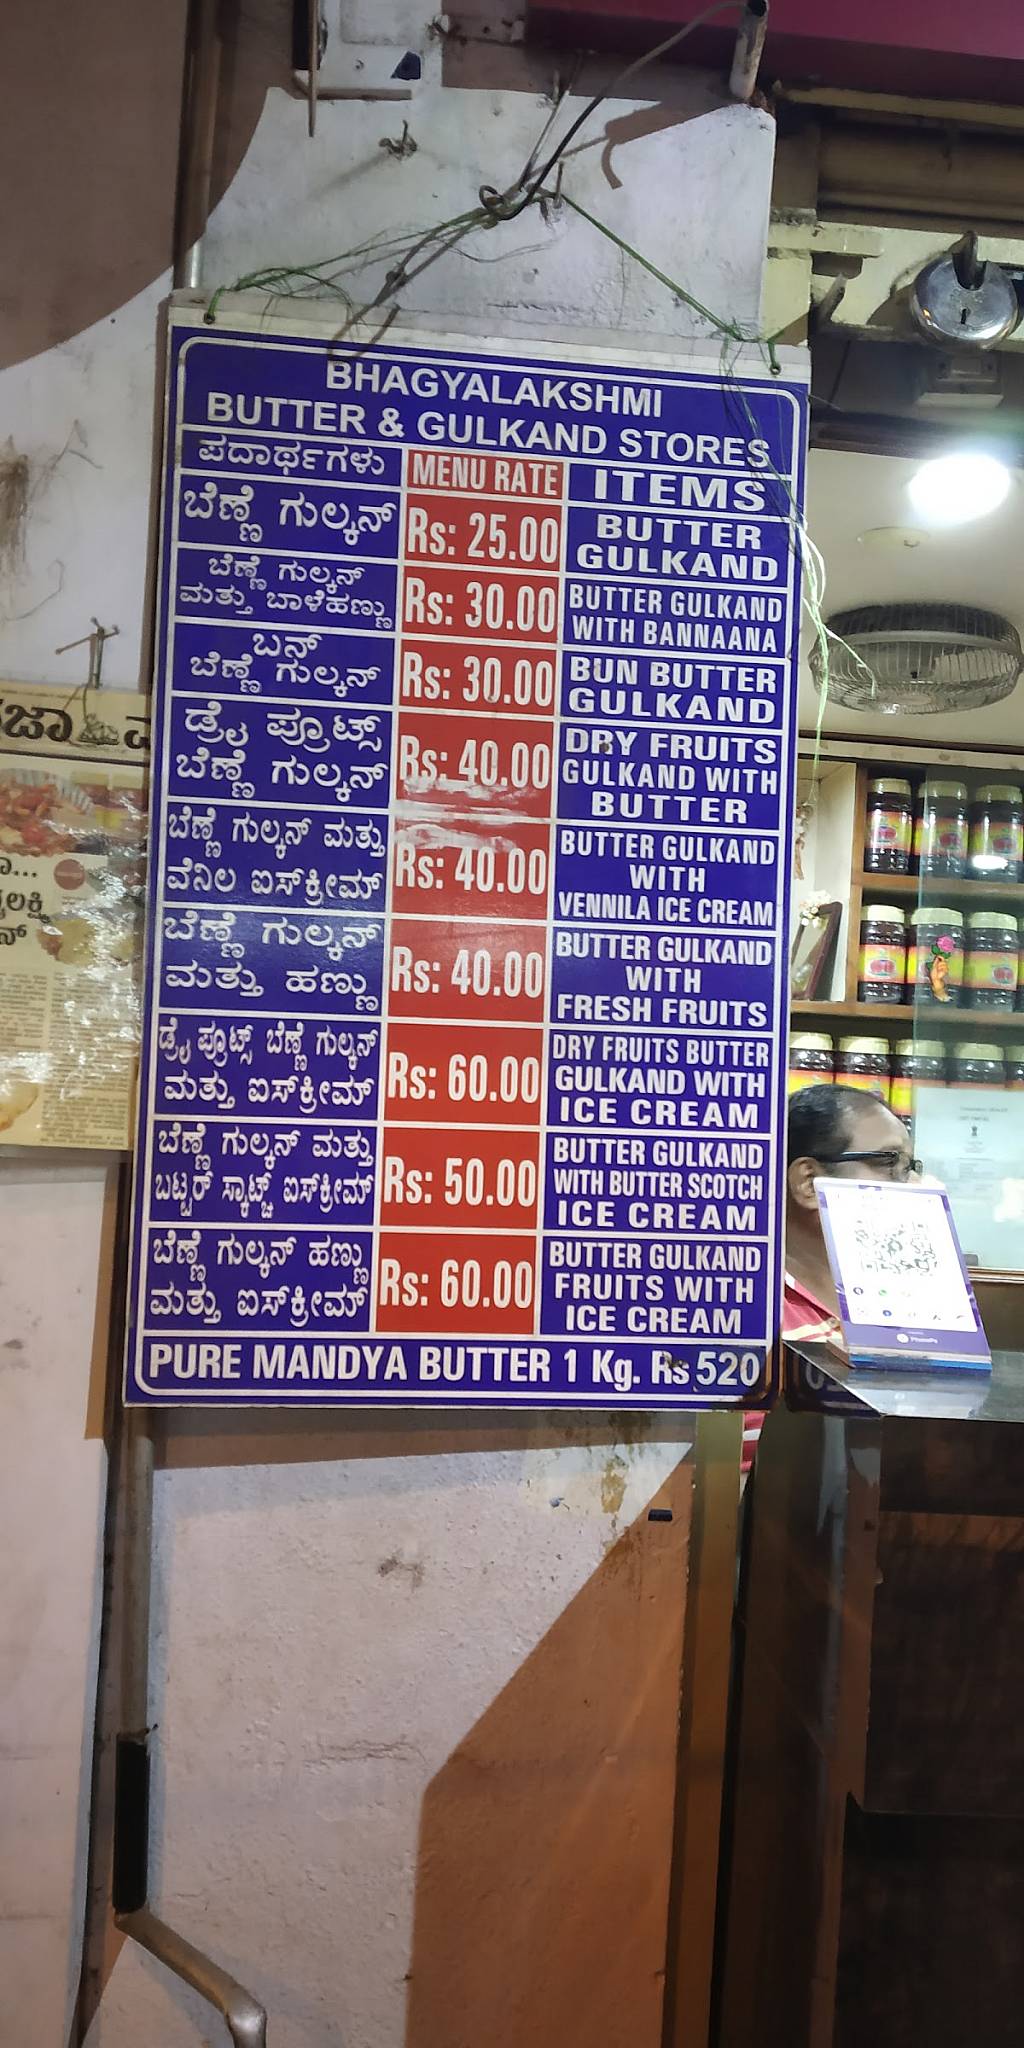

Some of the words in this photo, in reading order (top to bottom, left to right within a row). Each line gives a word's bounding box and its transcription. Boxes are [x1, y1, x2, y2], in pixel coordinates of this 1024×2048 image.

[327, 362, 661, 417] BHAGYALAKSHMI
[208, 392, 365, 434] BUTTER
[378, 408, 404, 437] &
[418, 412, 606, 453] GULKAND
[619, 429, 772, 467] STORES
[200, 435, 384, 475] ಪದಾರ್ಥಗಳು
[413, 453, 486, 489] MENU
[495, 461, 558, 495] RATE
[595, 469, 765, 511] ITEMS
[184, 482, 262, 542] ಬೆಣ್ಣೆ
[280, 492, 396, 545] ಗುಲ್ಕನ್
[597, 514, 761, 549] BUTTER
[408, 507, 455, 555] Rs:
[468, 513, 558, 563] 25.00
[209, 554, 266, 590] ಬೆಣ್ಣೆ
[279, 561, 364, 594] ಗುಲ್ಕನ್
[577, 544, 777, 581] GULKAND
[181, 583, 253, 614] ಮತ್ತು
[267, 590, 392, 628] ಬಾಳೆಹಣ್ಣು
[405, 577, 453, 625] Rs:
[465, 582, 555, 632] 30.00
[570, 584, 662, 614] BUTTER
[671, 591, 782, 622] GULKAND
[253, 634, 322, 658] ಬನ್
[573, 615, 634, 643] WITH
[644, 620, 776, 652] BANNAANA
[191, 652, 260, 693] ಬೆಣ್ಣೆ
[277, 659, 380, 697] ಗುಲ್ಕನ್
[403, 652, 450, 699] Rs:
[463, 656, 552, 706] 30.00
[571, 656, 637, 684] BUN
[650, 662, 776, 693] BUTTER
[185, 701, 248, 746] ಡ್ರೈ
[569, 688, 774, 723] GULKAND
[400, 735, 447, 782] Rs:
[458, 739, 551, 790] 40.00
[566, 728, 637, 755] DRY
[650, 733, 776, 764] FRUITS
[177, 747, 255, 798] ಬೆಣ್ಣೆ
[272, 755, 388, 802] ಗುಲ್ಕನ್
[563, 759, 695, 790] GULKAND
[706, 767, 777, 794] WITH
[592, 791, 746, 823] BUTTER
[169, 806, 221, 857] ಬೆಣ್ಣೆ
[233, 813, 311, 859] ಗುಲ್ಕನ್
[324, 818, 385, 857] ಮತ್ತು
[561, 830, 654, 859] BUTTER
[663, 836, 774, 864] GULKAND
[168, 858, 236, 892] ವೆನಿಲ
[395, 840, 444, 889] Rs:
[455, 849, 546, 894] 40.00
[630, 865, 705, 892] WITH
[559, 892, 650, 920] VENNILA
[658, 897, 691, 922] ICE
[698, 899, 773, 926] CREAM
[164, 912, 245, 958] ಬೆಣ್ಣೆ
[262, 917, 381, 961] ಗುಲ್ಕನ್
[556, 932, 650, 960] BUTTER
[658, 937, 772, 965] GULKAND
[166, 960, 263, 996] ಮತ್ತು
[286, 965, 378, 1011] ಹಣ್ಣು
[392, 946, 441, 993] Rs:
[450, 949, 543, 996] 40.00
[626, 966, 701, 993] WITH
[558, 994, 651, 1022] FRESH
[663, 999, 766, 1027] FRUITS
[159, 1017, 190, 1064] ಡ್ರೈ
[267, 1021, 307, 1071] ಬೆಣ್ಣೆ
[316, 1025, 378, 1070] ಗುಲ್ಕನ್
[553, 1034, 595, 1060] DRY
[603, 1036, 678, 1063] FRUITS
[687, 1040, 768, 1066] BUTTER
[165, 1070, 235, 1108] ಮತ್ತು
[388, 1052, 436, 1099] Rs:
[448, 1054, 539, 1103] 60.00
[556, 1065, 685, 1094] GULKAND
[694, 1071, 765, 1097] WITH
[561, 1097, 617, 1123] ICE
[631, 1099, 757, 1128] CREAM
[159, 1122, 210, 1170] ಬೆಣ್ಣೆ
[222, 1127, 300, 1170] ಗುಲ್ಕನ್
[313, 1129, 373, 1166] ಮತ್ತು
[554, 1137, 645, 1165] BUTTER
[653, 1141, 763, 1168] GULKAND
[156, 1171, 213, 1216] ಬಟ್ಟರ್
[384, 1156, 432, 1203] Rs:
[445, 1158, 536, 1207] 50.00
[554, 1169, 603, 1195] WITH
[610, 1171, 682, 1197] BUTTER
[688, 1173, 762, 1200] SCOTCH
[559, 1200, 614, 1226] ICE
[629, 1203, 755, 1231] CREAM
[154, 1230, 206, 1281] ಬೆಣ್ಣೆ
[218, 1234, 296, 1278] ಗುಲ್ಕನ್
[309, 1235, 368, 1284] ಹಣ್ಣು
[550, 1241, 641, 1268] BUTTER
[650, 1244, 760, 1271] GULKAND
[151, 1282, 221, 1323] ಮತ್ತು
[380, 1259, 428, 1306] Rs:
[441, 1260, 532, 1308] 60.00
[556, 1273, 663, 1300] FRUITS
[675, 1276, 753, 1303] WITH
[567, 1305, 616, 1331] ICE
[628, 1307, 740, 1334] CREAM
[150, 1344, 241, 1378] PURE
[254, 1345, 407, 1380] MANDYA
[420, 1347, 550, 1381] BUTTER
[564, 1349, 576, 1382] 1
[593, 1350, 640, 1391] Kg.
[652, 1351, 689, 1384] Rs
[696, 1351, 759, 1386] 520
